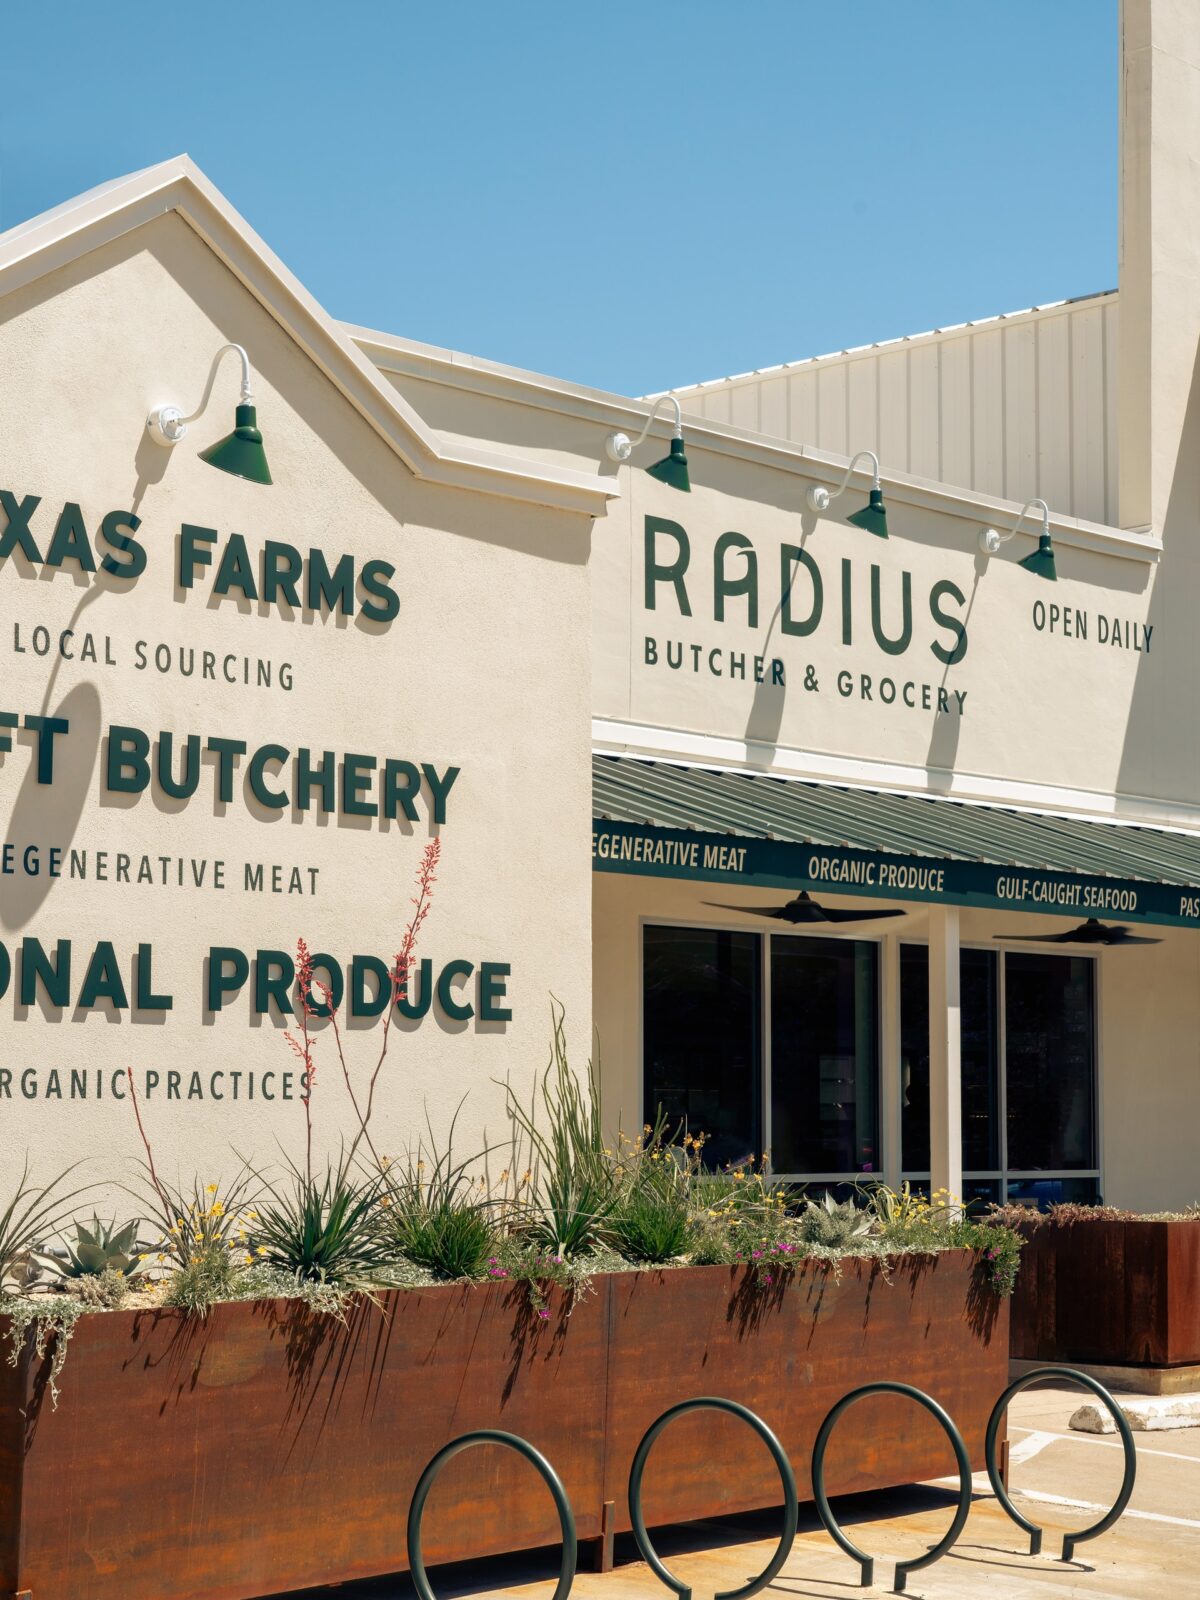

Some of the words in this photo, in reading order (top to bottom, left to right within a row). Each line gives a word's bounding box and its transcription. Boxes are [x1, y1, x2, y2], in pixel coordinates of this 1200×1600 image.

[0, 490, 147, 579] XAS
[180, 523, 400, 622] FARMS
[644, 515, 968, 665] RADIUS
[14, 622, 117, 666] LOCAL
[134, 640, 294, 691] SOURCING
[1033, 600, 1087, 640] OPEN
[1098, 614, 1153, 653] DAILY
[644, 637, 785, 686] BUTCHER
[803, 665, 820, 692] &
[838, 671, 968, 715] GROCERY
[107, 725, 460, 825] BUTCHERY
[2, 844, 226, 889] EGENERATIVE
[244, 863, 320, 895] MEAT
[703, 845, 746, 871] MEAT
[808, 856, 875, 885] ORGANIC
[878, 864, 945, 892] PRODUCE
[996, 876, 1081, 905] GULF-CAUGHT
[1083, 886, 1137, 911] SEAFOOD
[0, 937, 173, 1010] NAL
[208, 947, 513, 1022] PRODUCE
[0, 1068, 126, 1099] RGANIC
[145, 1070, 312, 1101] PRACTICES
